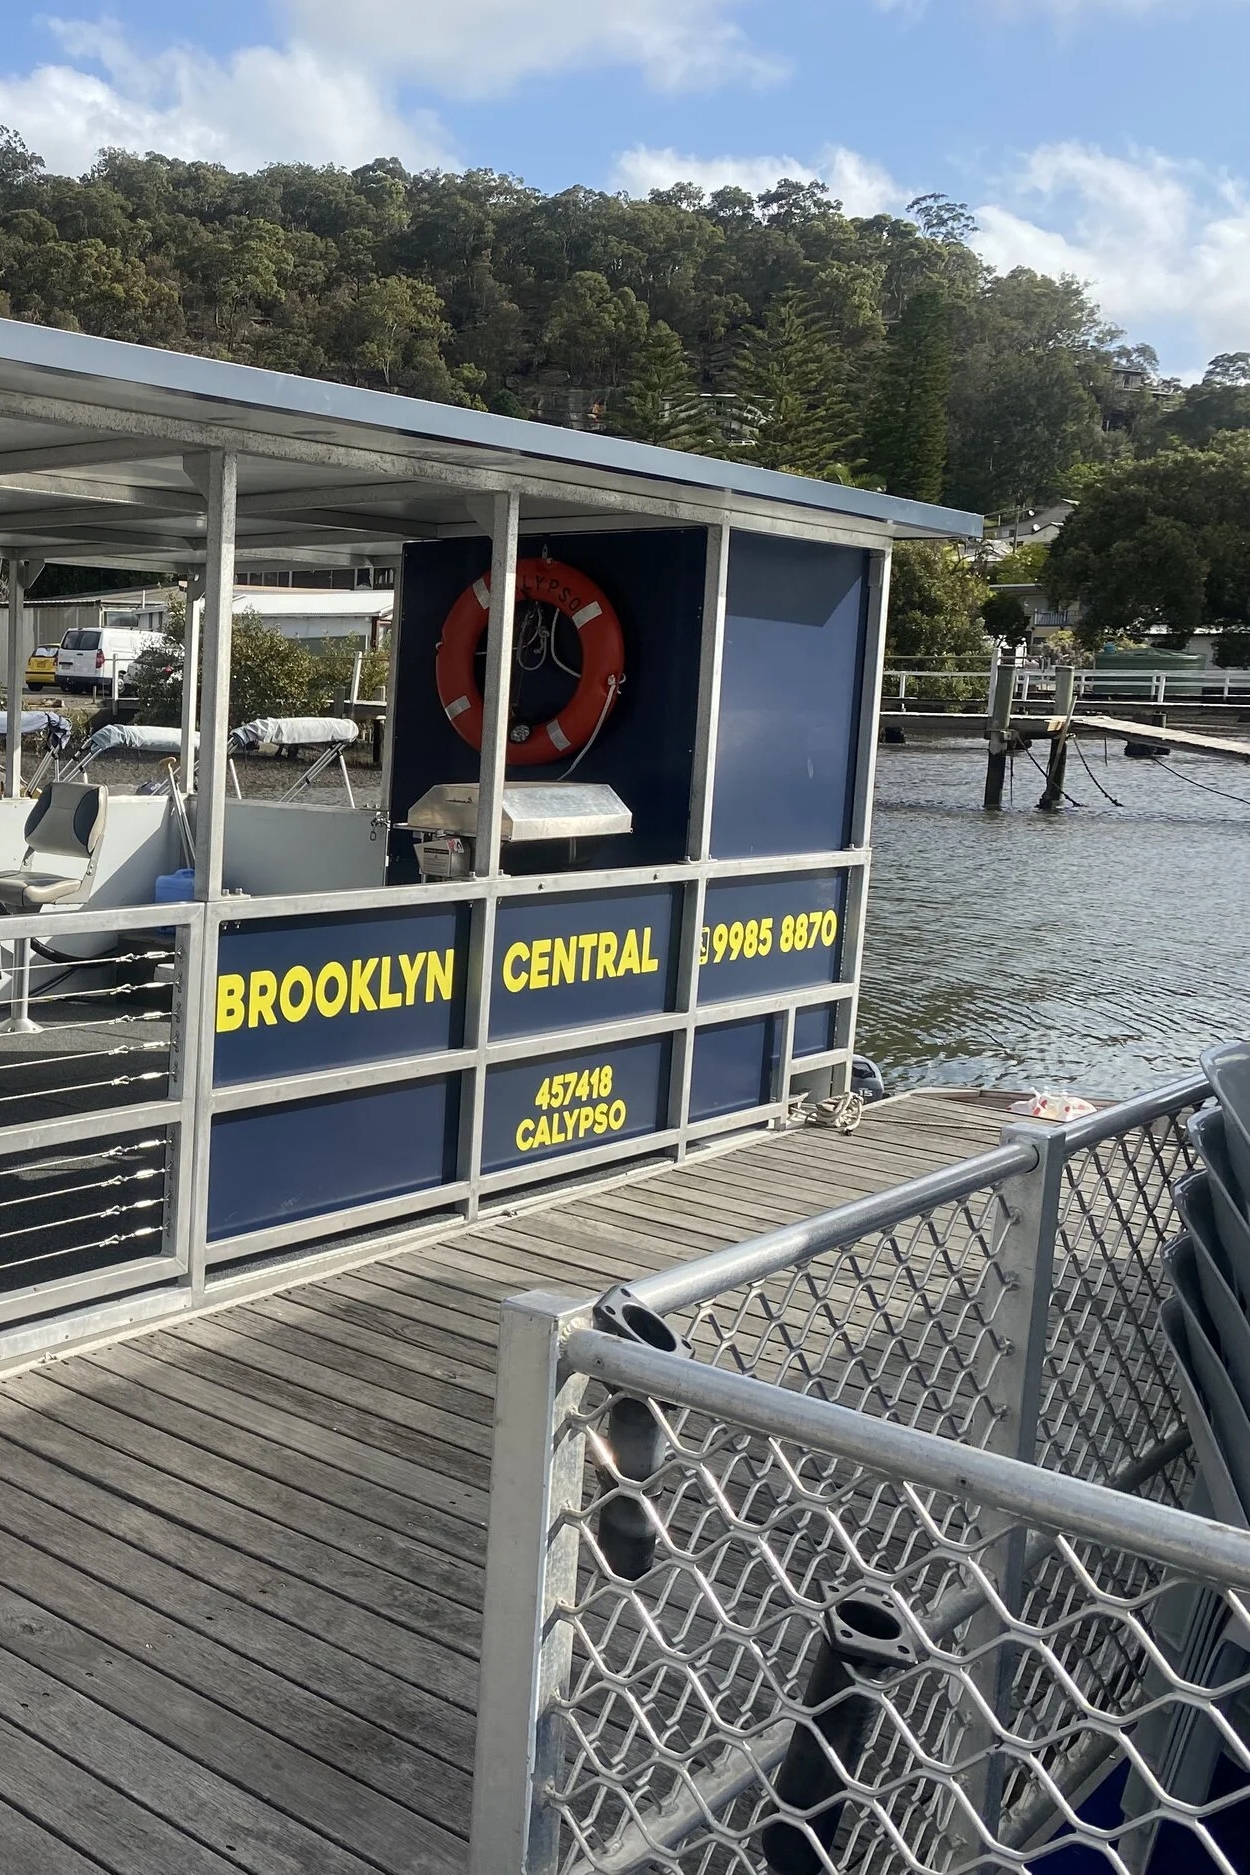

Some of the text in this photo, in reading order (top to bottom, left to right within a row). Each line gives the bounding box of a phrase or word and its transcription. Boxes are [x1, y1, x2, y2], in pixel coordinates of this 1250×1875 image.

[516, 574, 581, 611] LYPSO
[712, 909, 838, 964] 9985 8870
[216, 928, 659, 1033] BROOKLYN CENTRAL
[535, 1066, 613, 1108] 457418
[516, 1099, 627, 1151] CALYPSO
